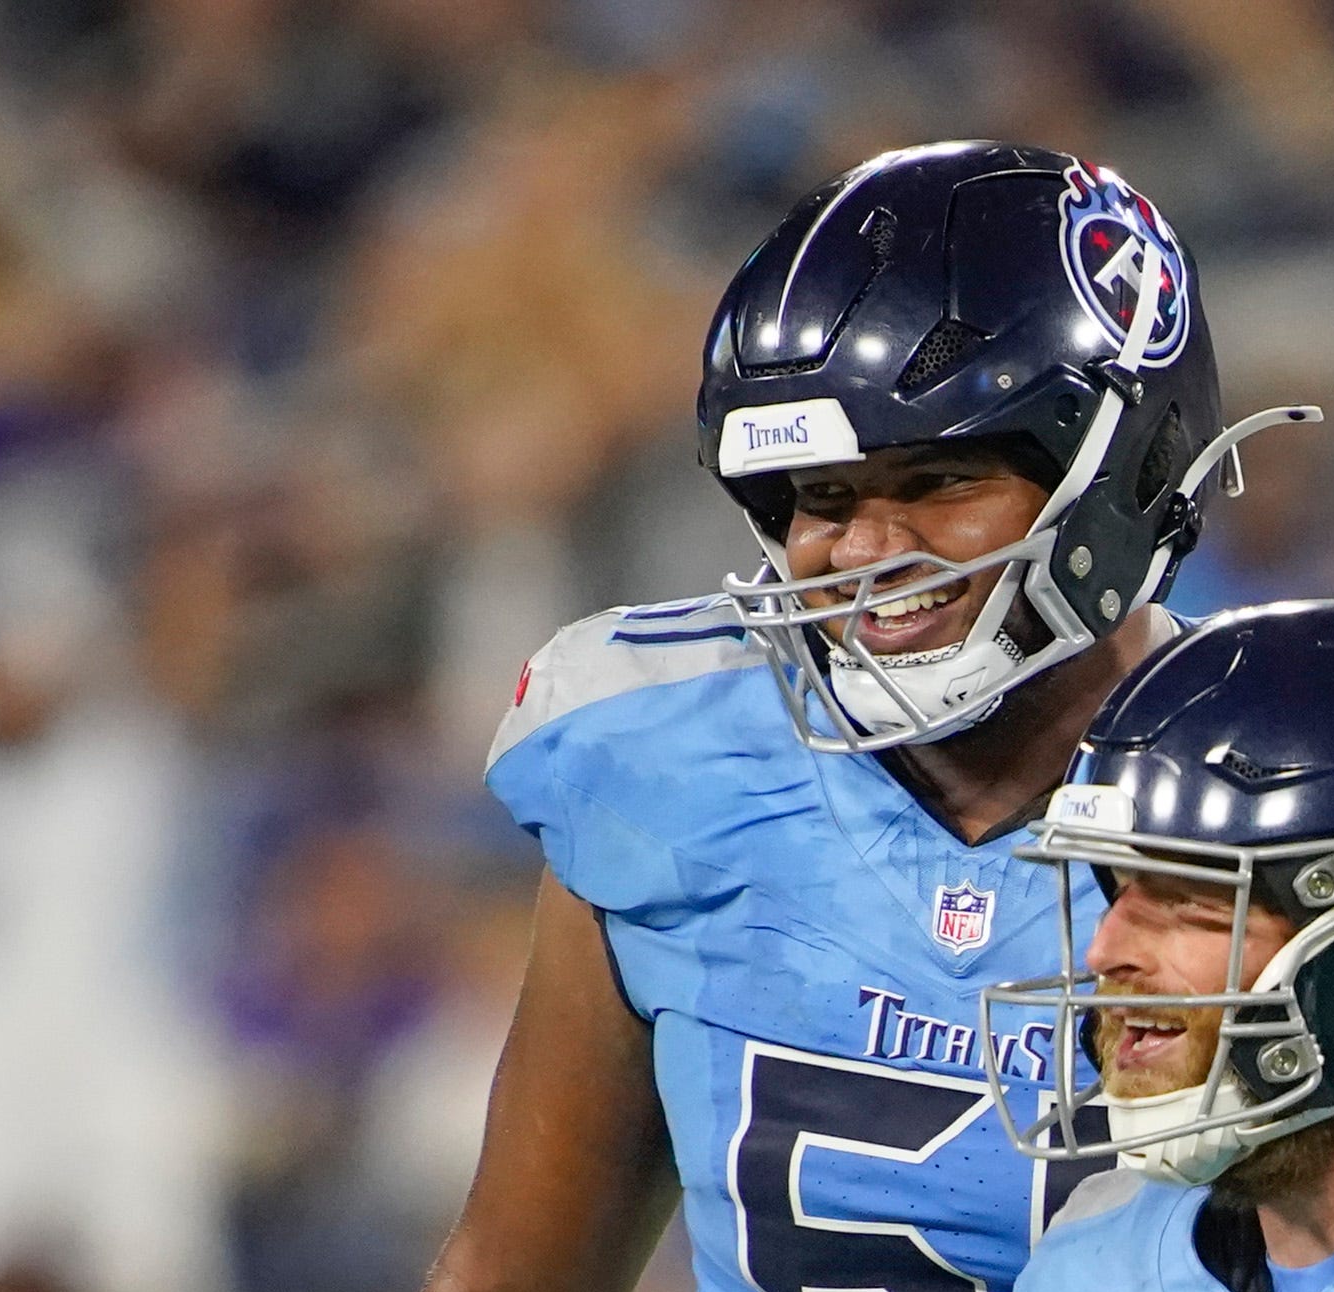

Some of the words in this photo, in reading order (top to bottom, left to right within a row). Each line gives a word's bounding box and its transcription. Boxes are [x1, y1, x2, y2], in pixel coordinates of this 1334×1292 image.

[743, 415, 809, 451] TITANS
[941, 912, 980, 941] NFL
[858, 985, 1056, 1081] TITANS
